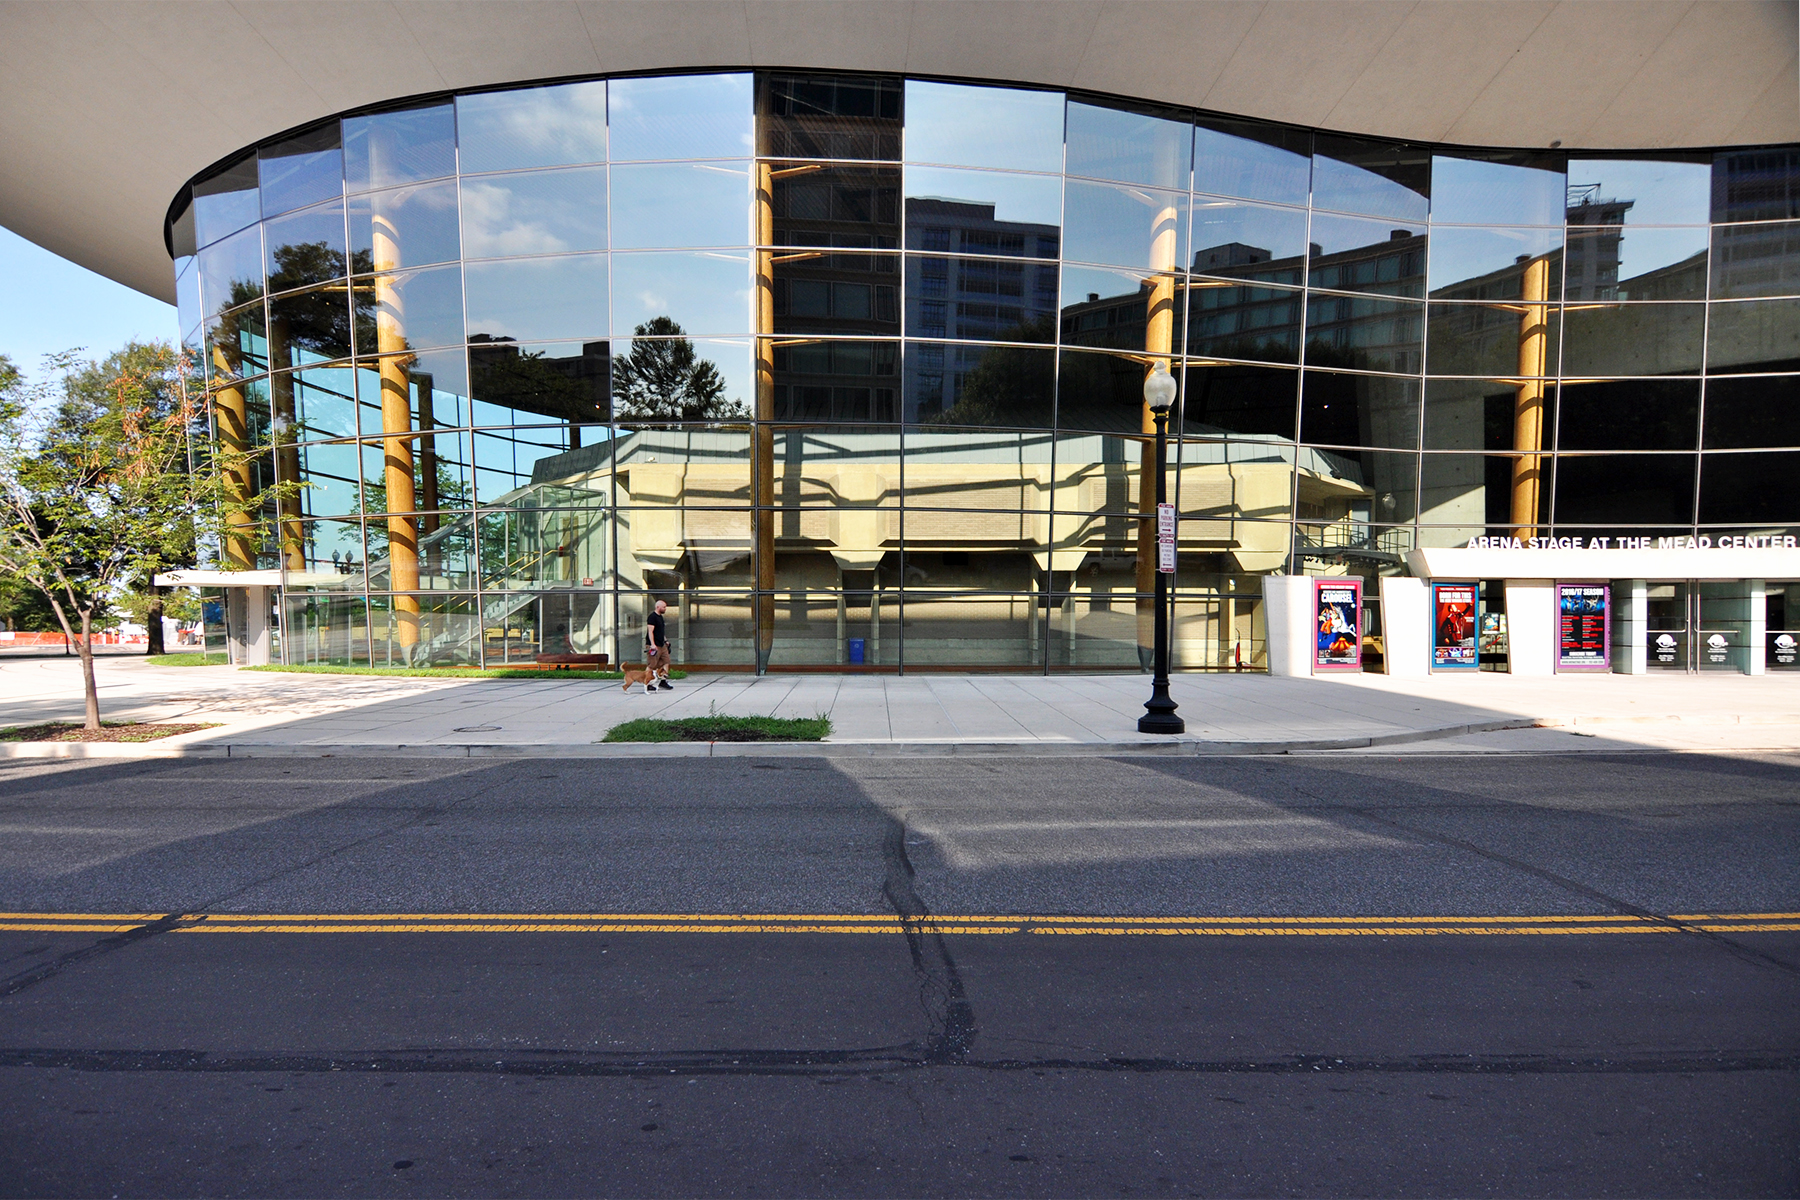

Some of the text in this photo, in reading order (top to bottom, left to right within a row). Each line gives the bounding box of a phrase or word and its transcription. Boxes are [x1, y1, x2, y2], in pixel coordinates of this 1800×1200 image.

[1467, 535, 1797, 549] ARENA STAGE AT THE MEAD CENTER
[1583, 588, 1604, 596] SEASON
